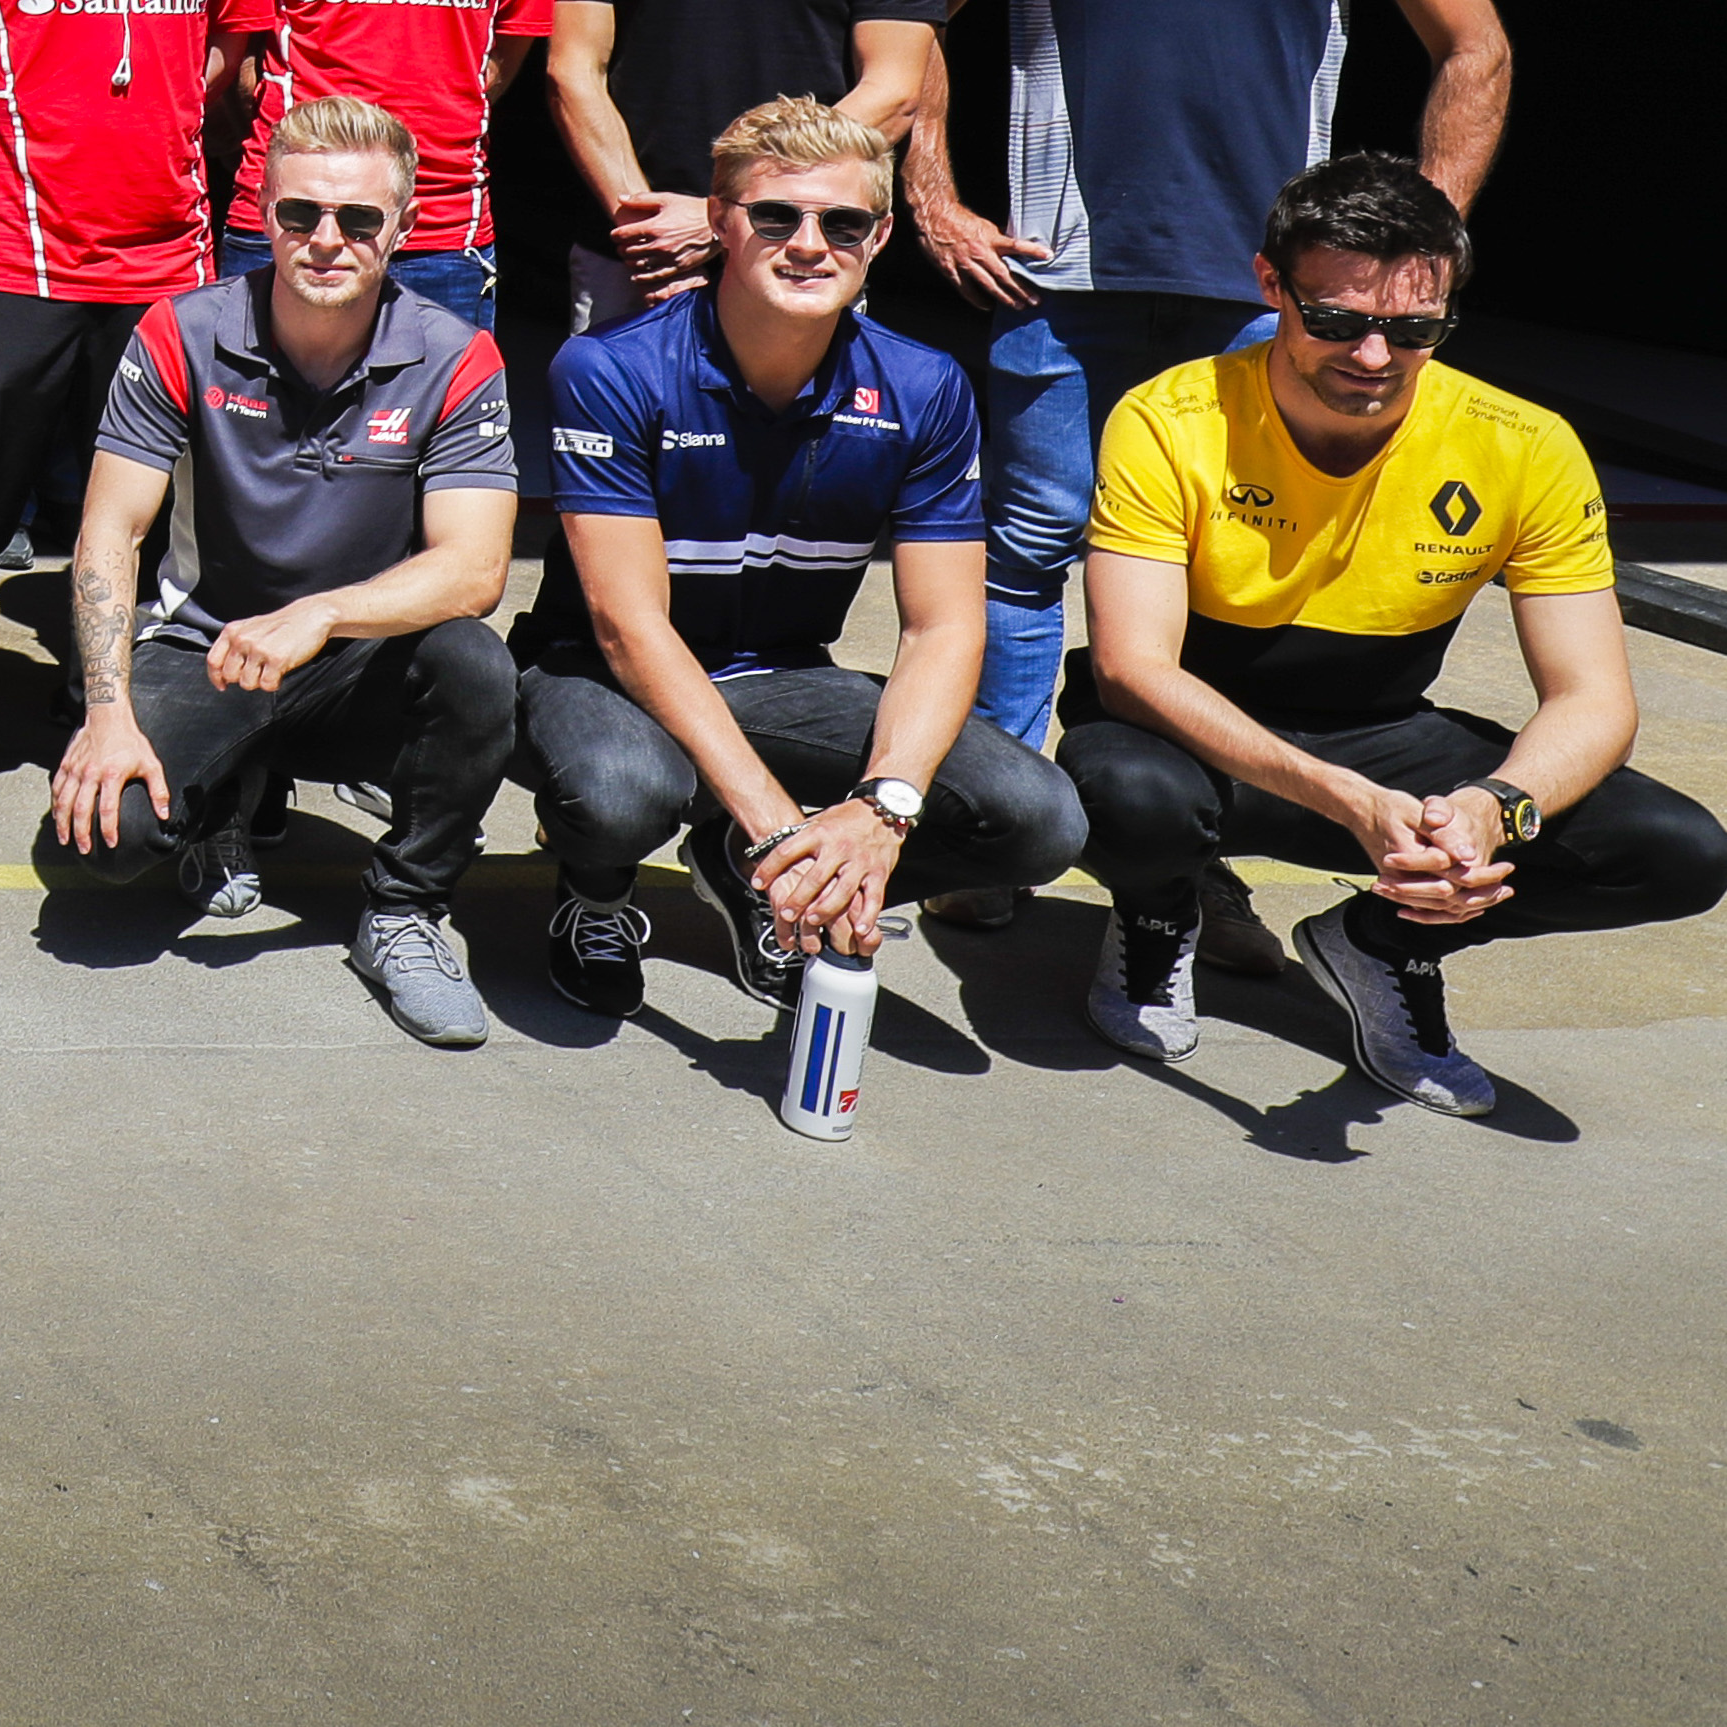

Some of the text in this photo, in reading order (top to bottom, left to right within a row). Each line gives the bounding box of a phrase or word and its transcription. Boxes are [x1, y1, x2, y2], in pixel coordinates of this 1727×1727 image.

[239, 405, 268, 419] Team
[1468, 396, 1519, 419] Microsoft
[1465, 406, 1516, 430] Dynamics
[1415, 543, 1494, 556] RENAULT
[1137, 916, 1177, 935] APL
